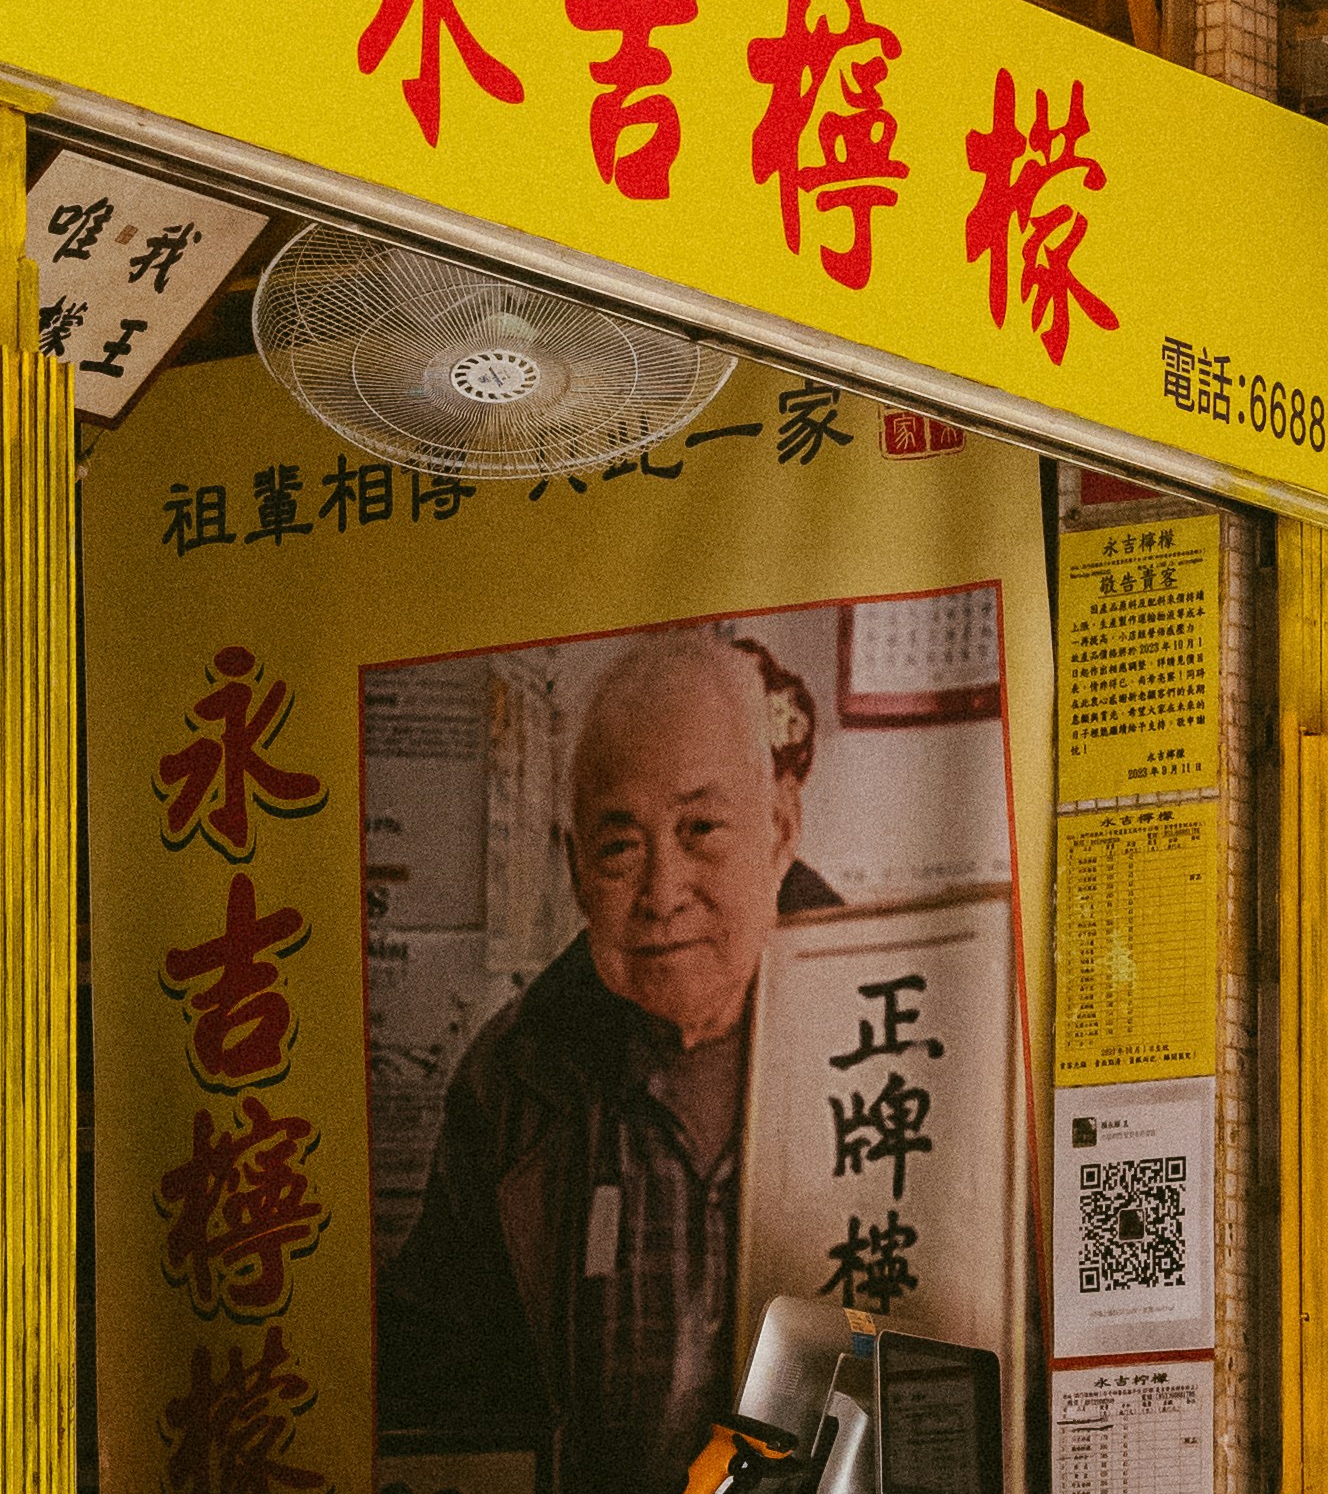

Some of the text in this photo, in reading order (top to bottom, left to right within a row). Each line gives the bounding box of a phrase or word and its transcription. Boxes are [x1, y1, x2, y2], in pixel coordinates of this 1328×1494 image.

[1103, 529, 1177, 558] 永吉檸檬
[1100, 566, 1178, 595] 敬告貴客
